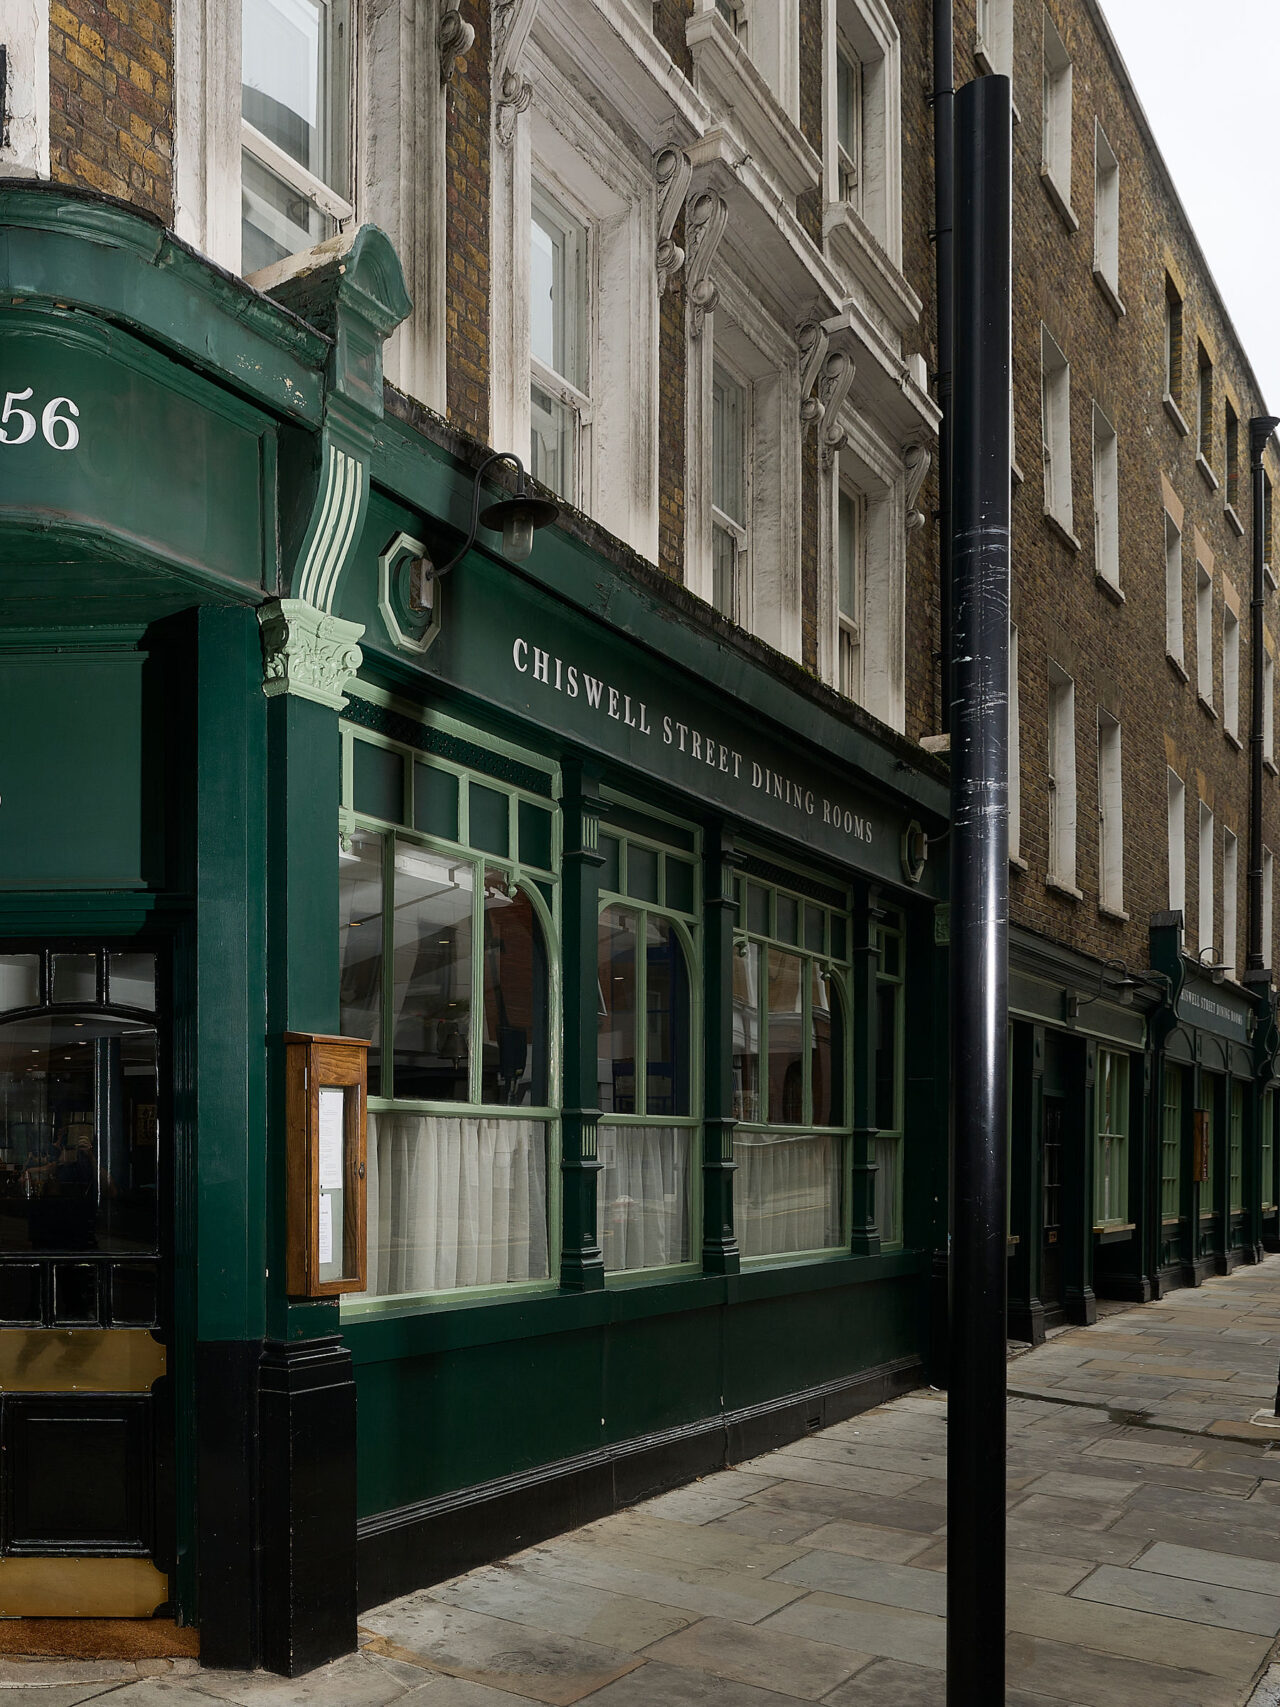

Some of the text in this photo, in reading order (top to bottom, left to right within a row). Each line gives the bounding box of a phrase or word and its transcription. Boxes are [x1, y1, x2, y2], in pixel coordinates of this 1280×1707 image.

[512, 638, 873, 844] CHISWELL STREET DINING ROOMS
